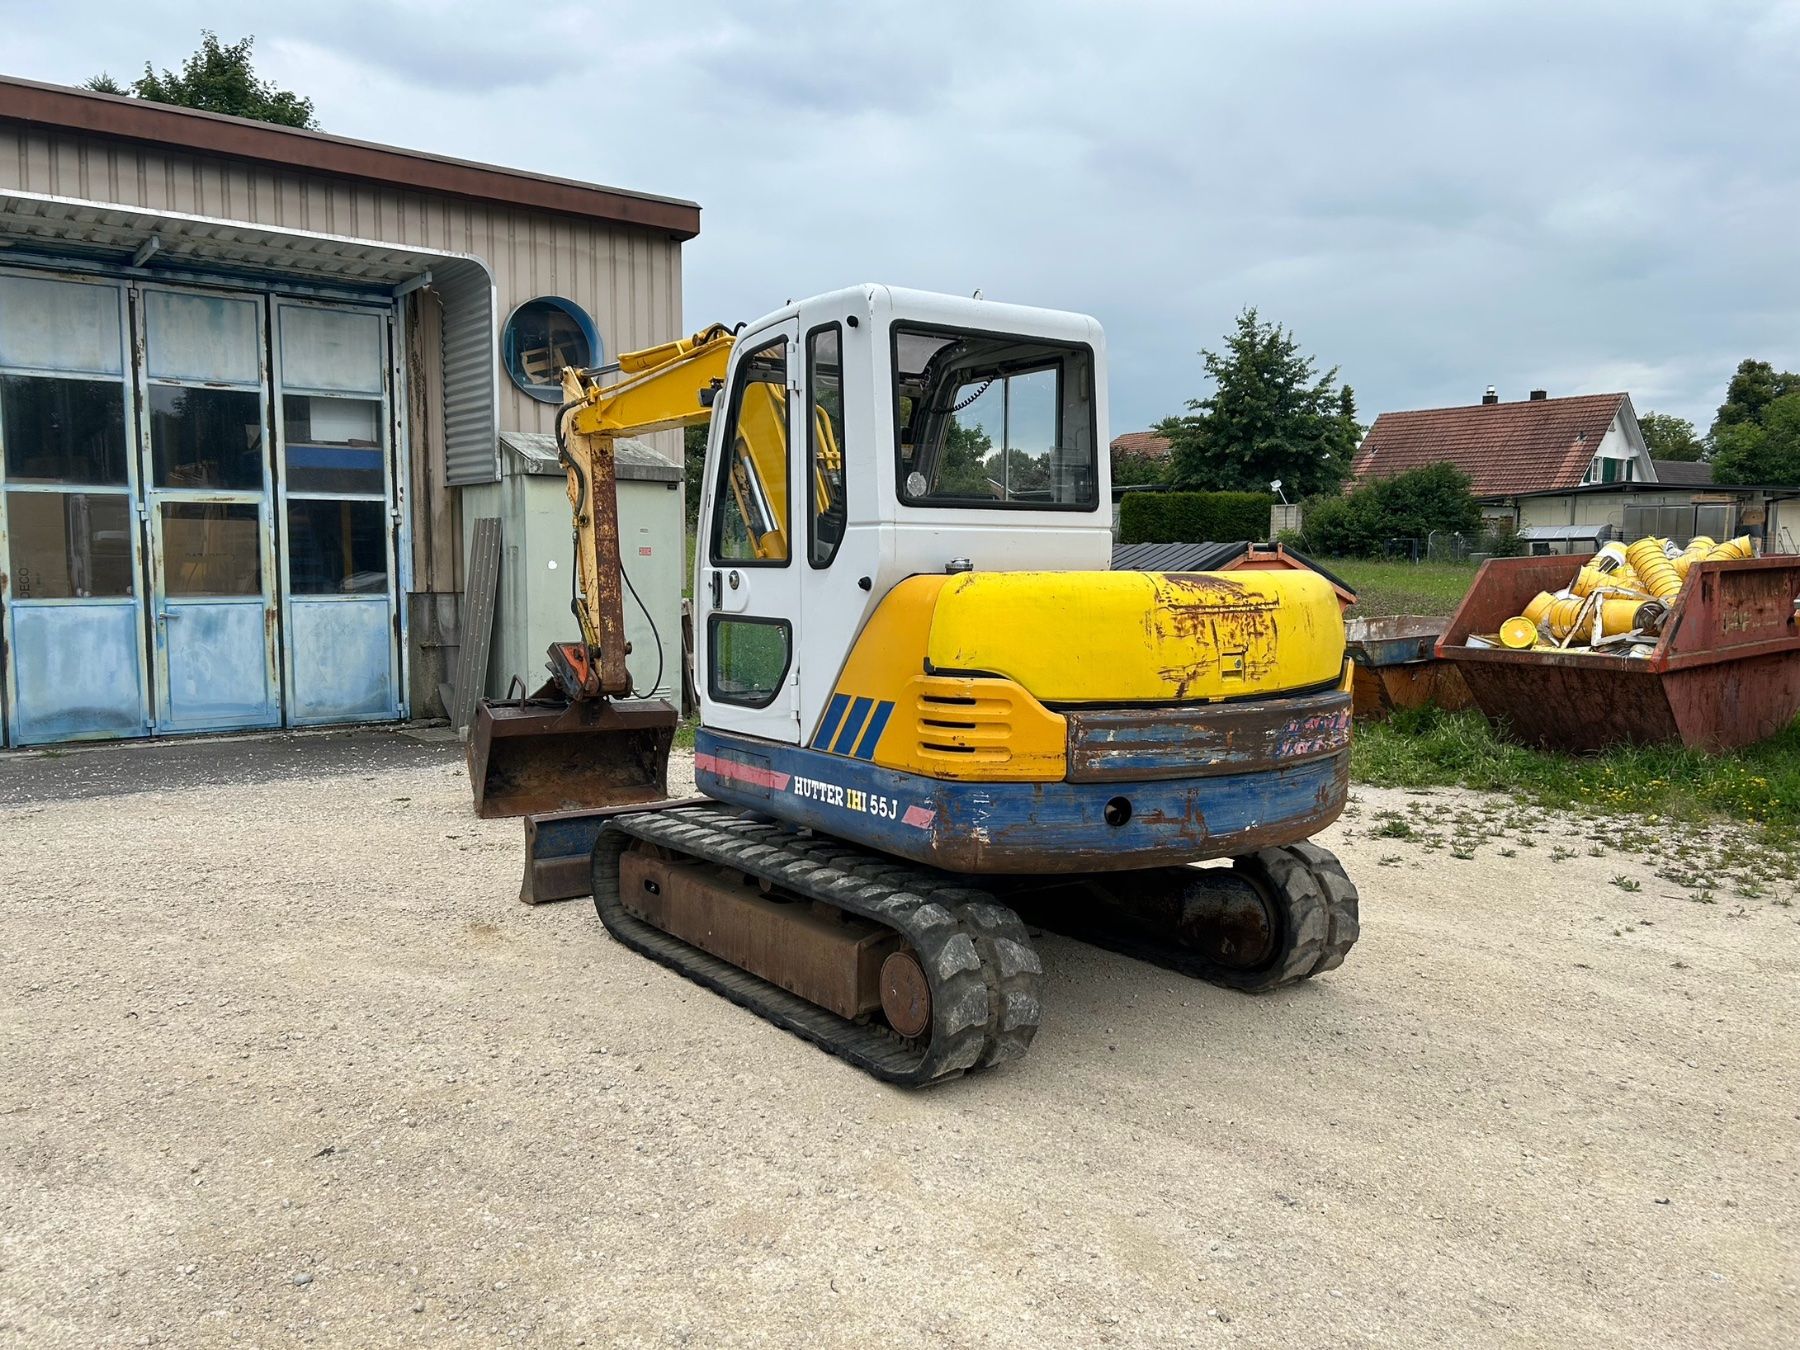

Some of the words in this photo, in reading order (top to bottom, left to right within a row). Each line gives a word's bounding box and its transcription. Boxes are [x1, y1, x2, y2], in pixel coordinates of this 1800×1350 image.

[794, 776, 844, 807] HUTTER
[846, 788, 867, 812] IHI
[870, 794, 898, 820] 55J
